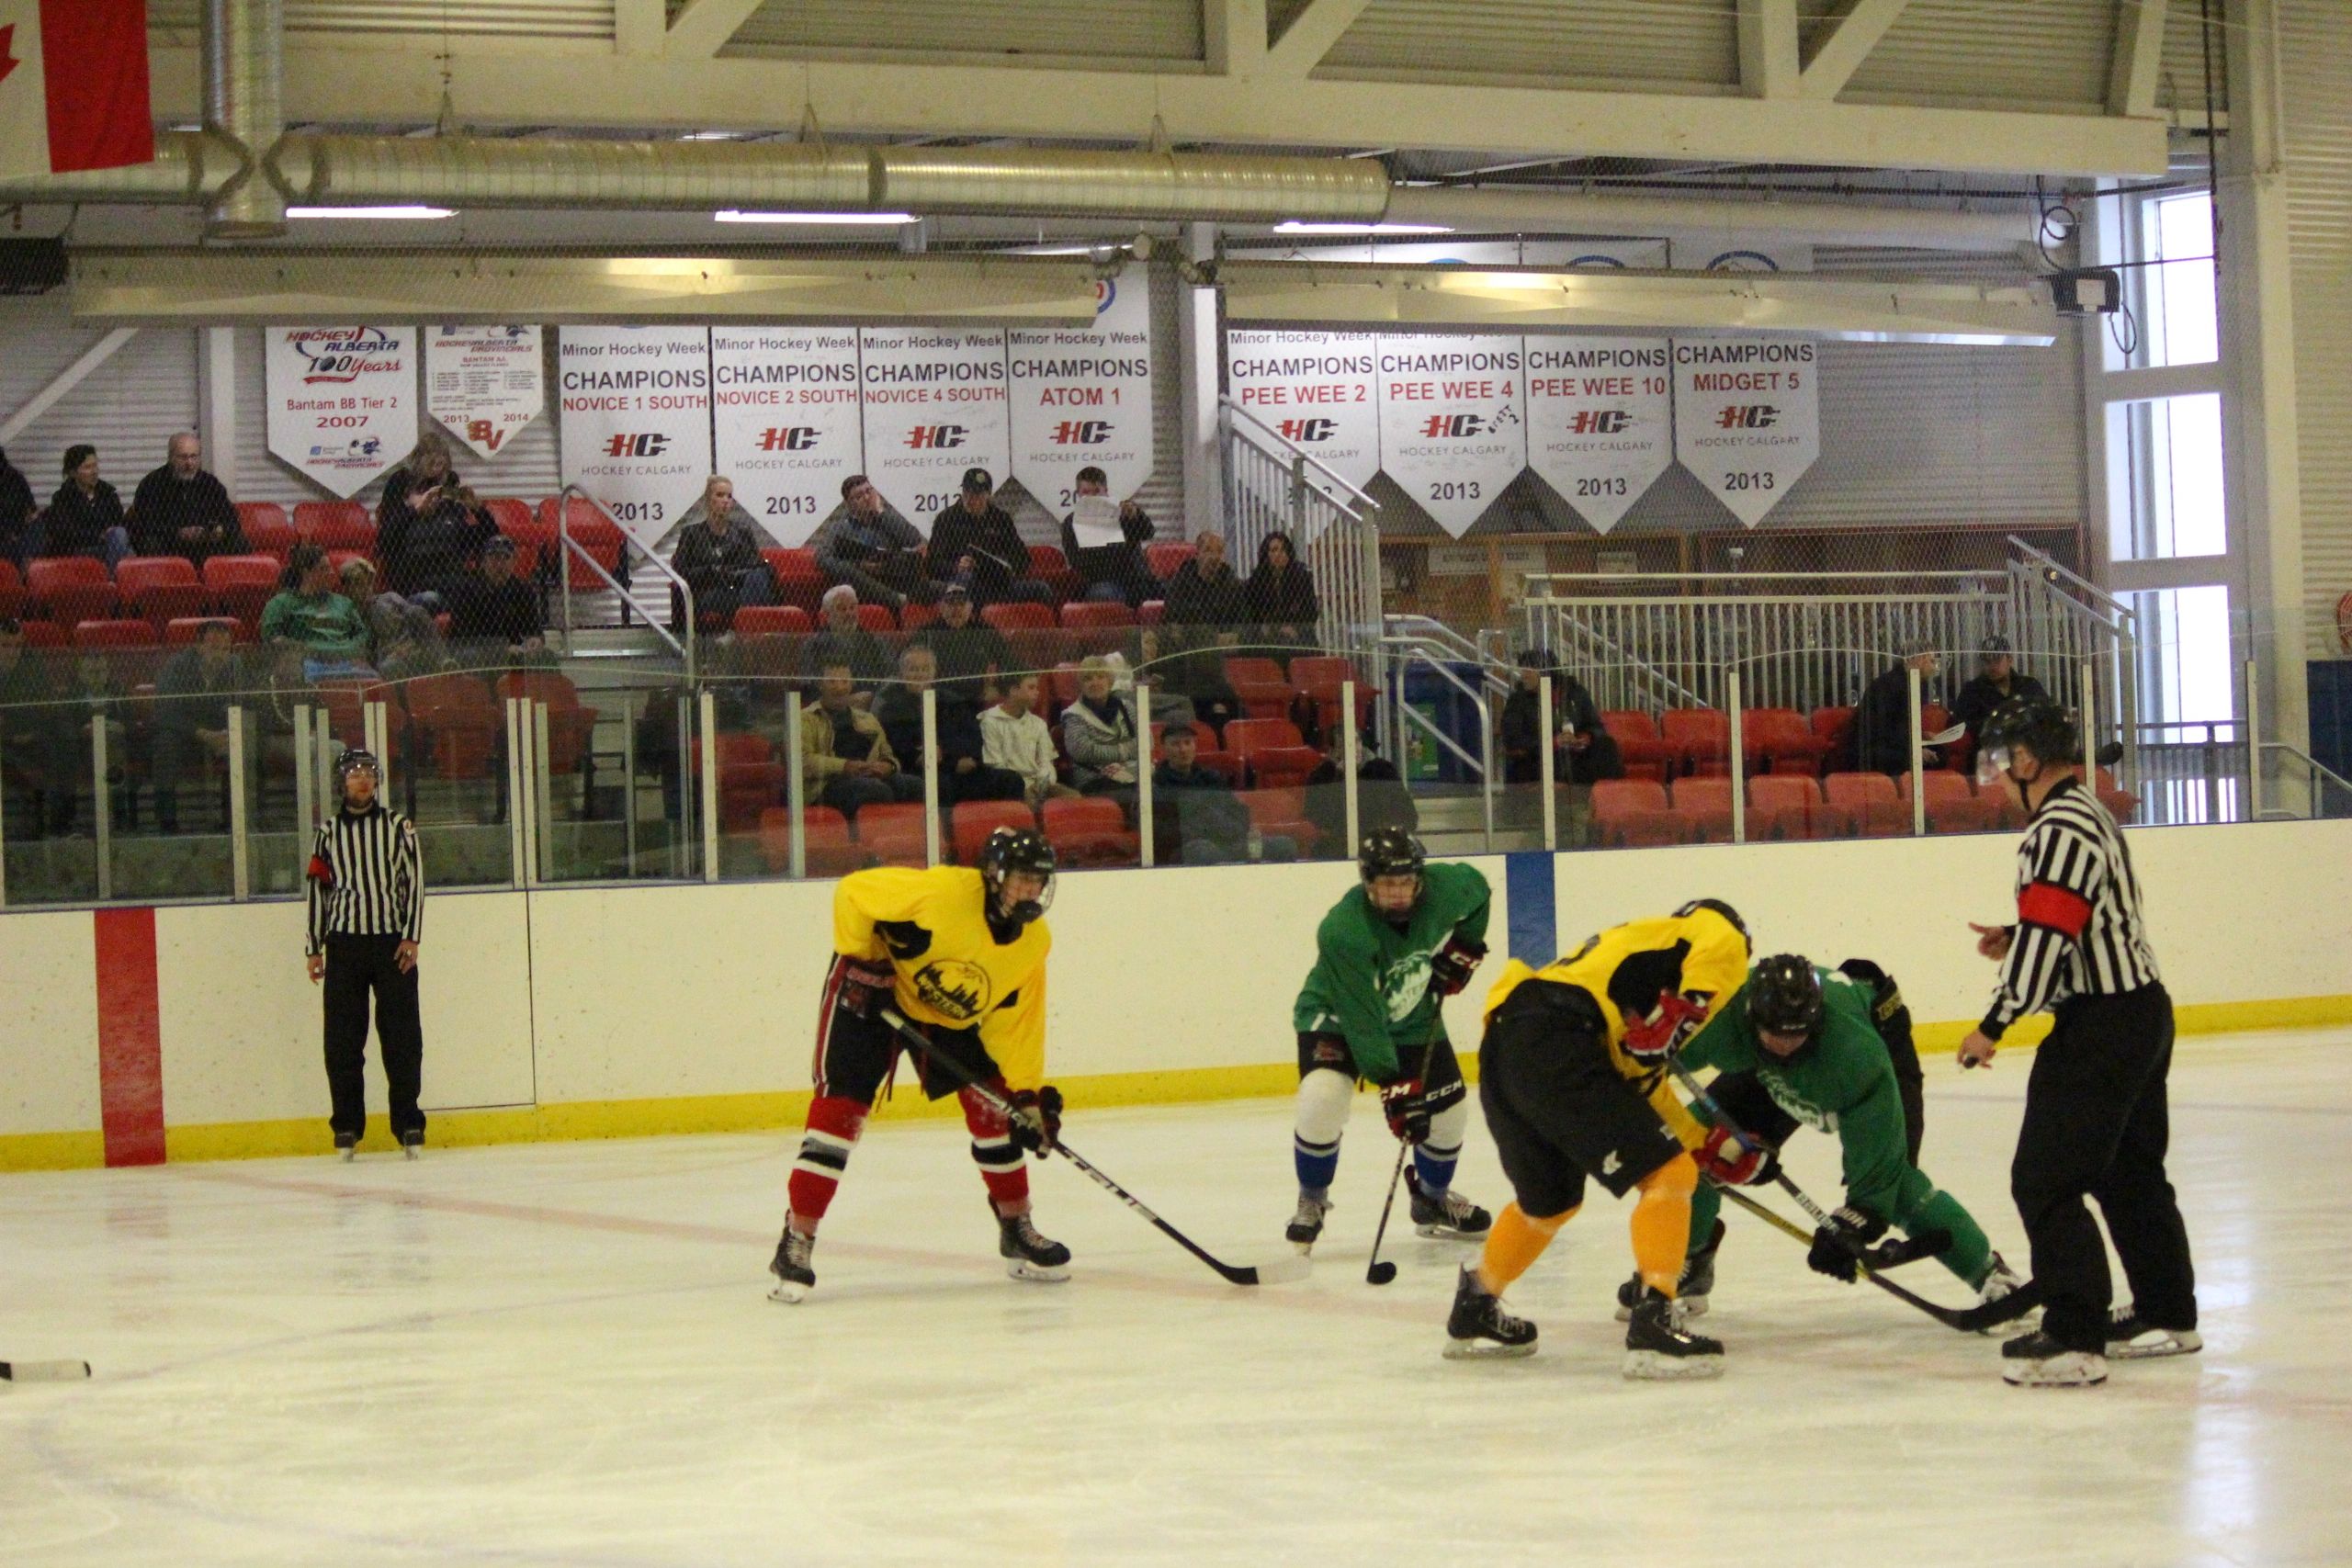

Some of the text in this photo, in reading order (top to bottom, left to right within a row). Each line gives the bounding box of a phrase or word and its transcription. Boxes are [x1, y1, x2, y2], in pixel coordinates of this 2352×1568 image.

[324, 341, 399, 352] ALBERTA
[715, 336, 855, 353] Minor Hockey Week
[864, 334, 1003, 351] Minor Hockey Week
[1011, 332, 1148, 347] Minor Hockey Week
[1230, 332, 1373, 345] Minor Hockey Week
[562, 342, 707, 358] Minor Hockey Week
[1528, 349, 1667, 369] CHAMPIONS
[1676, 344, 1814, 364] CHAMPIONS
[351, 358, 401, 374] Years
[865, 361, 1003, 383] CHAMPIONS
[1012, 359, 1148, 378] CHAMPIONS
[1232, 355, 1374, 378] CHAMPIONS
[1381, 353, 1520, 373] CHAMPIONS
[563, 369, 707, 390] CHAMPIONS
[717, 364, 855, 385] CHAMPIONS
[1693, 372, 1800, 391] MIDGET 5
[865, 387, 1005, 404] NOVICE 4 SOUTH
[1241, 384, 1366, 406] PEE WEE 2
[1390, 380, 1513, 401] PEE WEE 4
[1532, 377, 1666, 397] PEE WEE 10
[287, 397, 397, 411] Bantam BB Tier 2
[562, 395, 707, 412] NOVICE 1 SOUTH
[717, 389, 857, 405] NOVICE 2 SOUTH
[1040, 388, 1120, 406] ATOM 1
[316, 416, 368, 428] 2007
[444, 414, 470, 423] 2013
[503, 413, 528, 422] 2014
[1422, 414, 1483, 437] HC
[1569, 410, 1630, 434] HC
[1717, 405, 1779, 429] HC
[757, 427, 820, 451] HC
[906, 425, 967, 449] HC
[1051, 421, 1113, 445] HC
[1279, 419, 1337, 442] HC
[605, 434, 669, 457] HC
[1546, 441, 1653, 453] HOCKEY CALGARY
[1695, 436, 1800, 447] HOCKEY CALGARY
[1030, 451, 1136, 463] HOCKEY CALGARY
[1399, 446, 1507, 457] HOCKEY CALGARY
[582, 465, 691, 476] HOCKEY CALGARY
[736, 458, 842, 470] HOCKEY CALGARY
[884, 456, 990, 468] HOCKEY CALGARY
[1577, 478, 1627, 496] 2013
[1725, 472, 1774, 491] 2013
[1430, 482, 1480, 501] 2013
[613, 502, 663, 521] 2013
[766, 496, 816, 515] 2013
